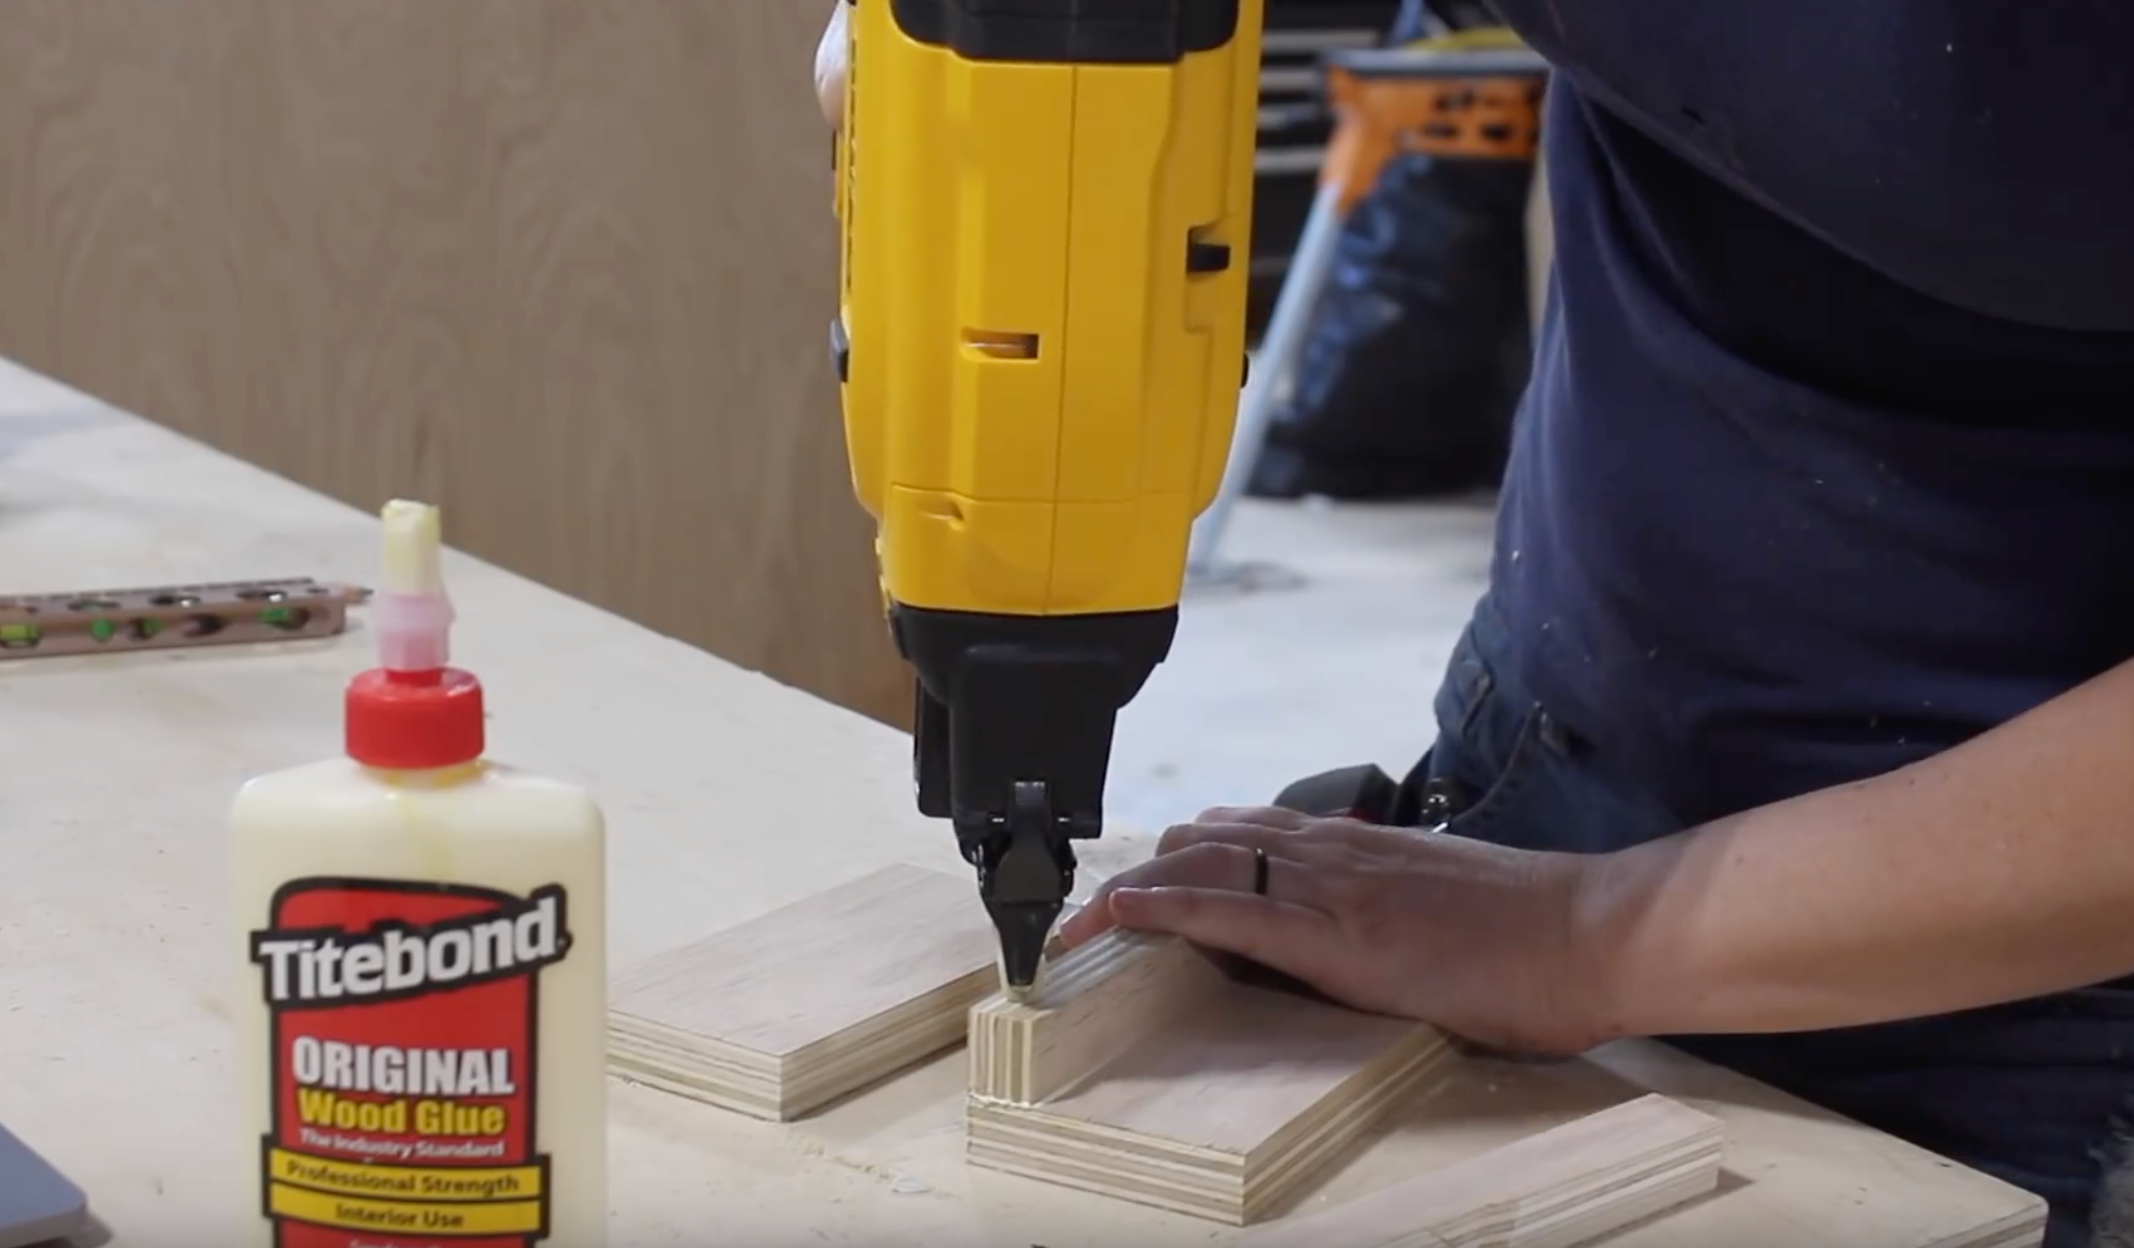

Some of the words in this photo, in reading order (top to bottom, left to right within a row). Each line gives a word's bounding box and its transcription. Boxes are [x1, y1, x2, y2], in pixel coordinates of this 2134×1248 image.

[260, 896, 557, 1000] Titebond
[292, 1036, 515, 1096] ORIGINAL
[298, 1087, 407, 1133] Wood
[416, 1099, 505, 1135] Glue
[415, 1140, 505, 1158] Standard
[287, 1158, 415, 1193] Professional
[421, 1173, 519, 1198] Strength
[336, 1202, 417, 1228] Interior
[423, 1209, 464, 1229] Use
